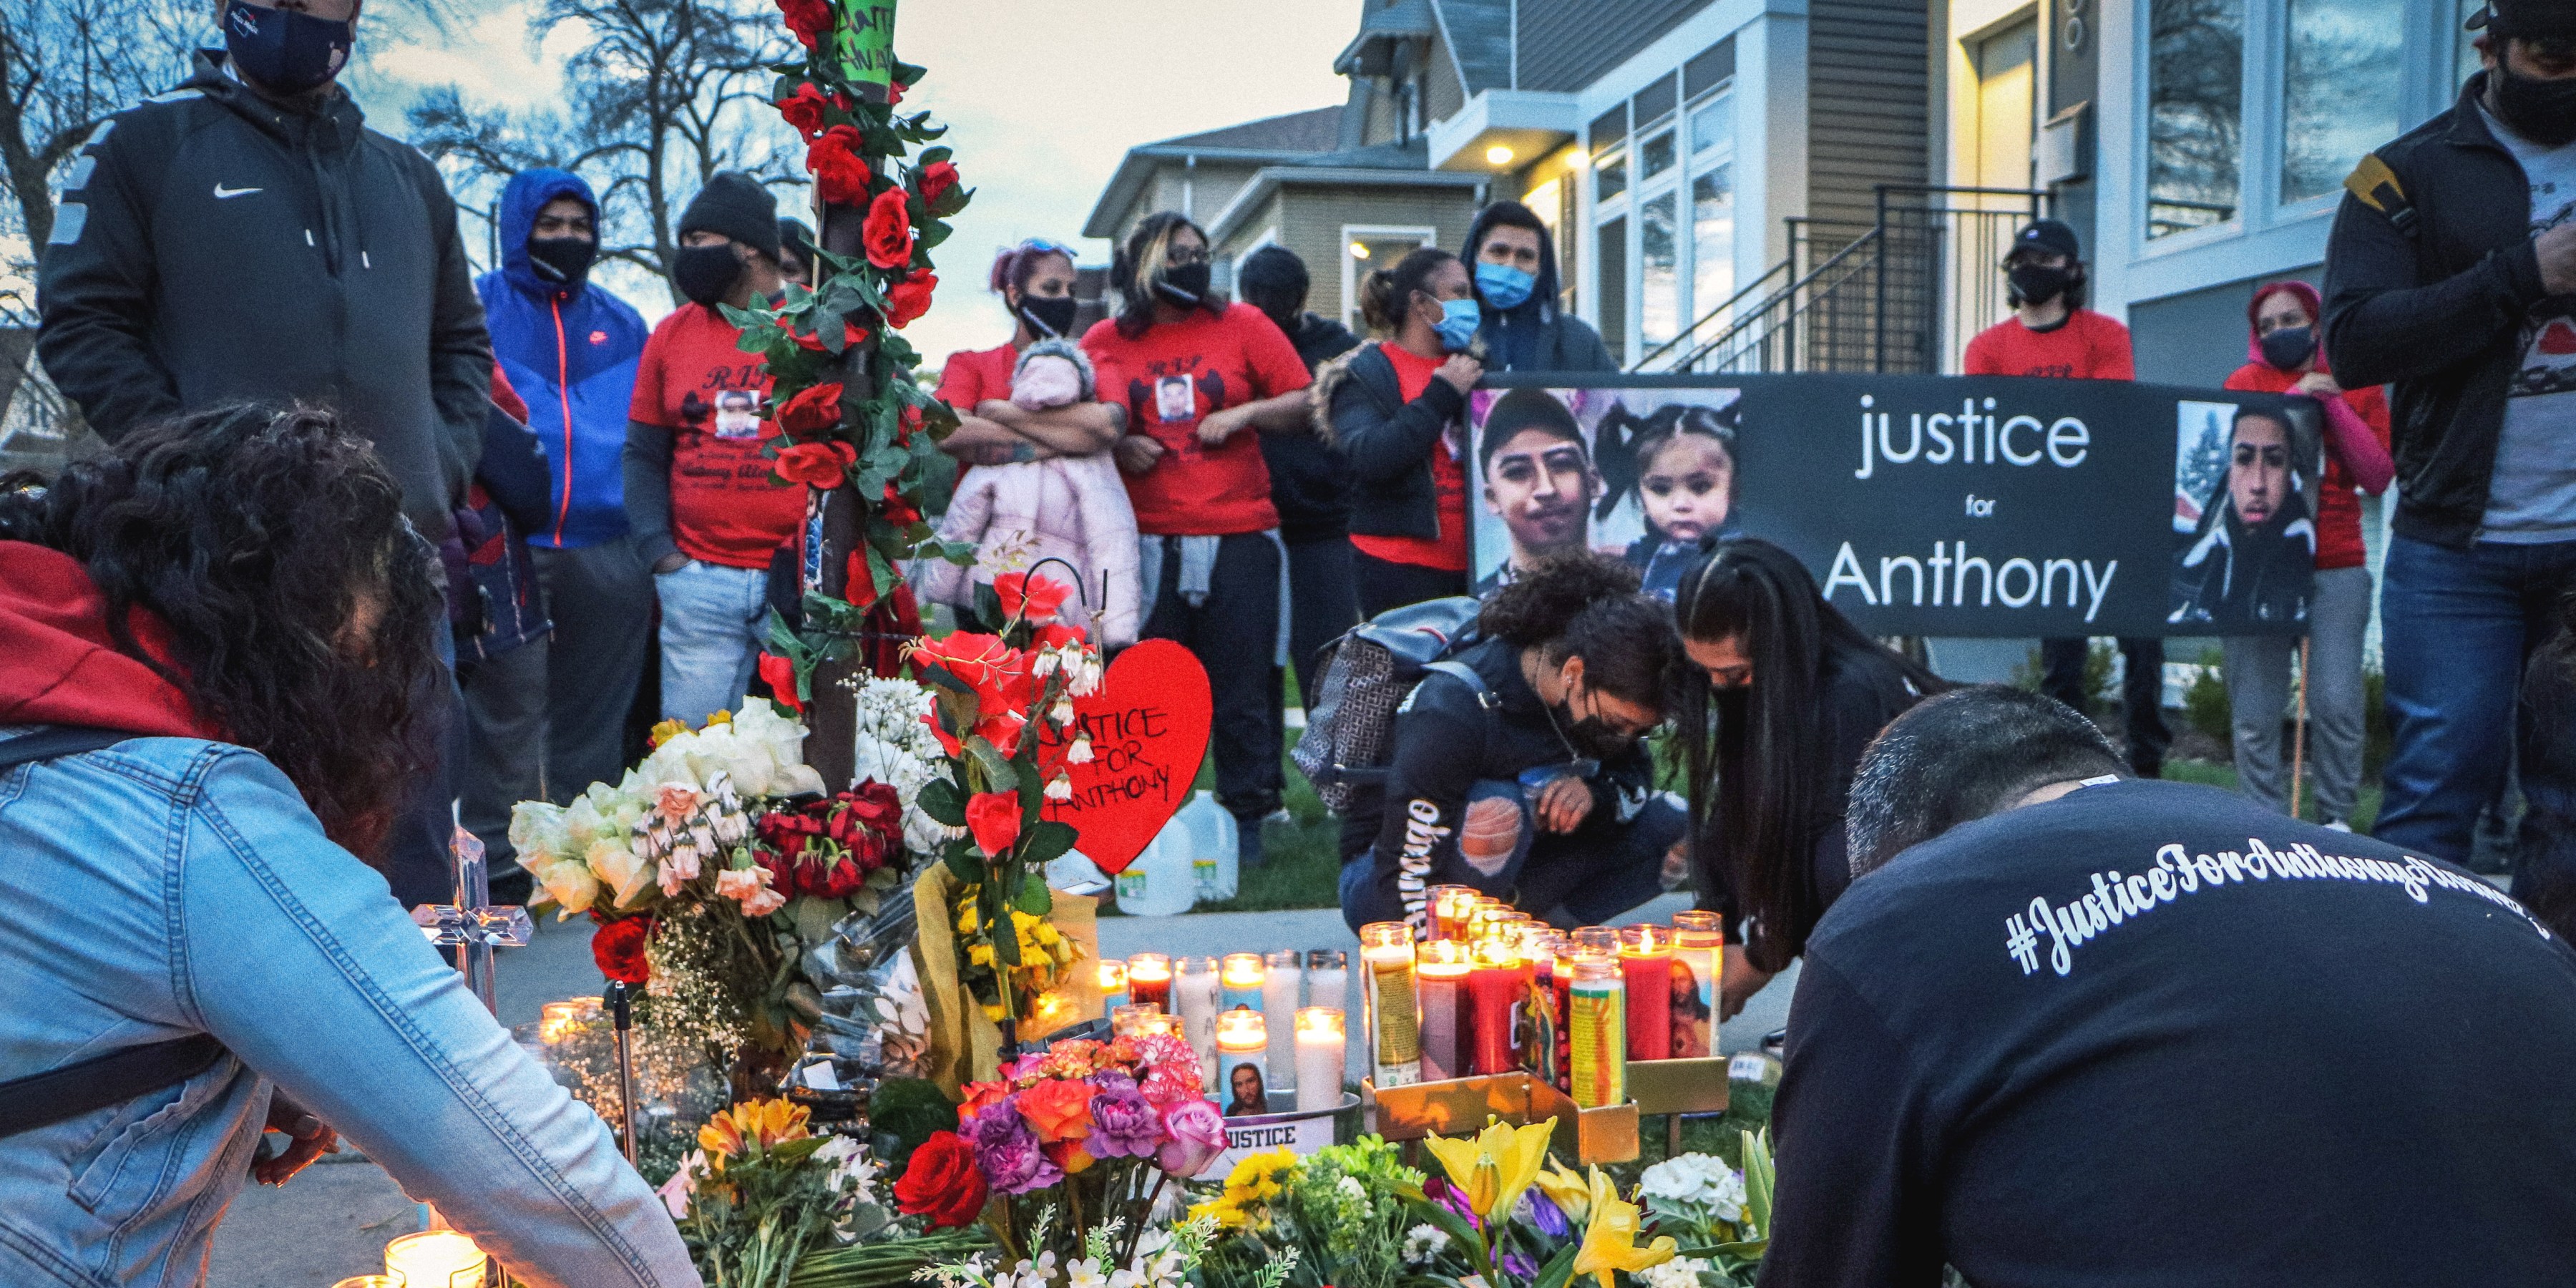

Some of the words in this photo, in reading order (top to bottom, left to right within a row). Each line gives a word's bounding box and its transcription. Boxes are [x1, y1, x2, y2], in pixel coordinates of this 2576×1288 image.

[1855, 394, 2089, 479] justice
[1966, 494, 1996, 517] for
[1822, 540, 2118, 623] Anthony
[1090, 740, 1153, 776] FOR
[1227, 1126, 1296, 1148] USTICE
